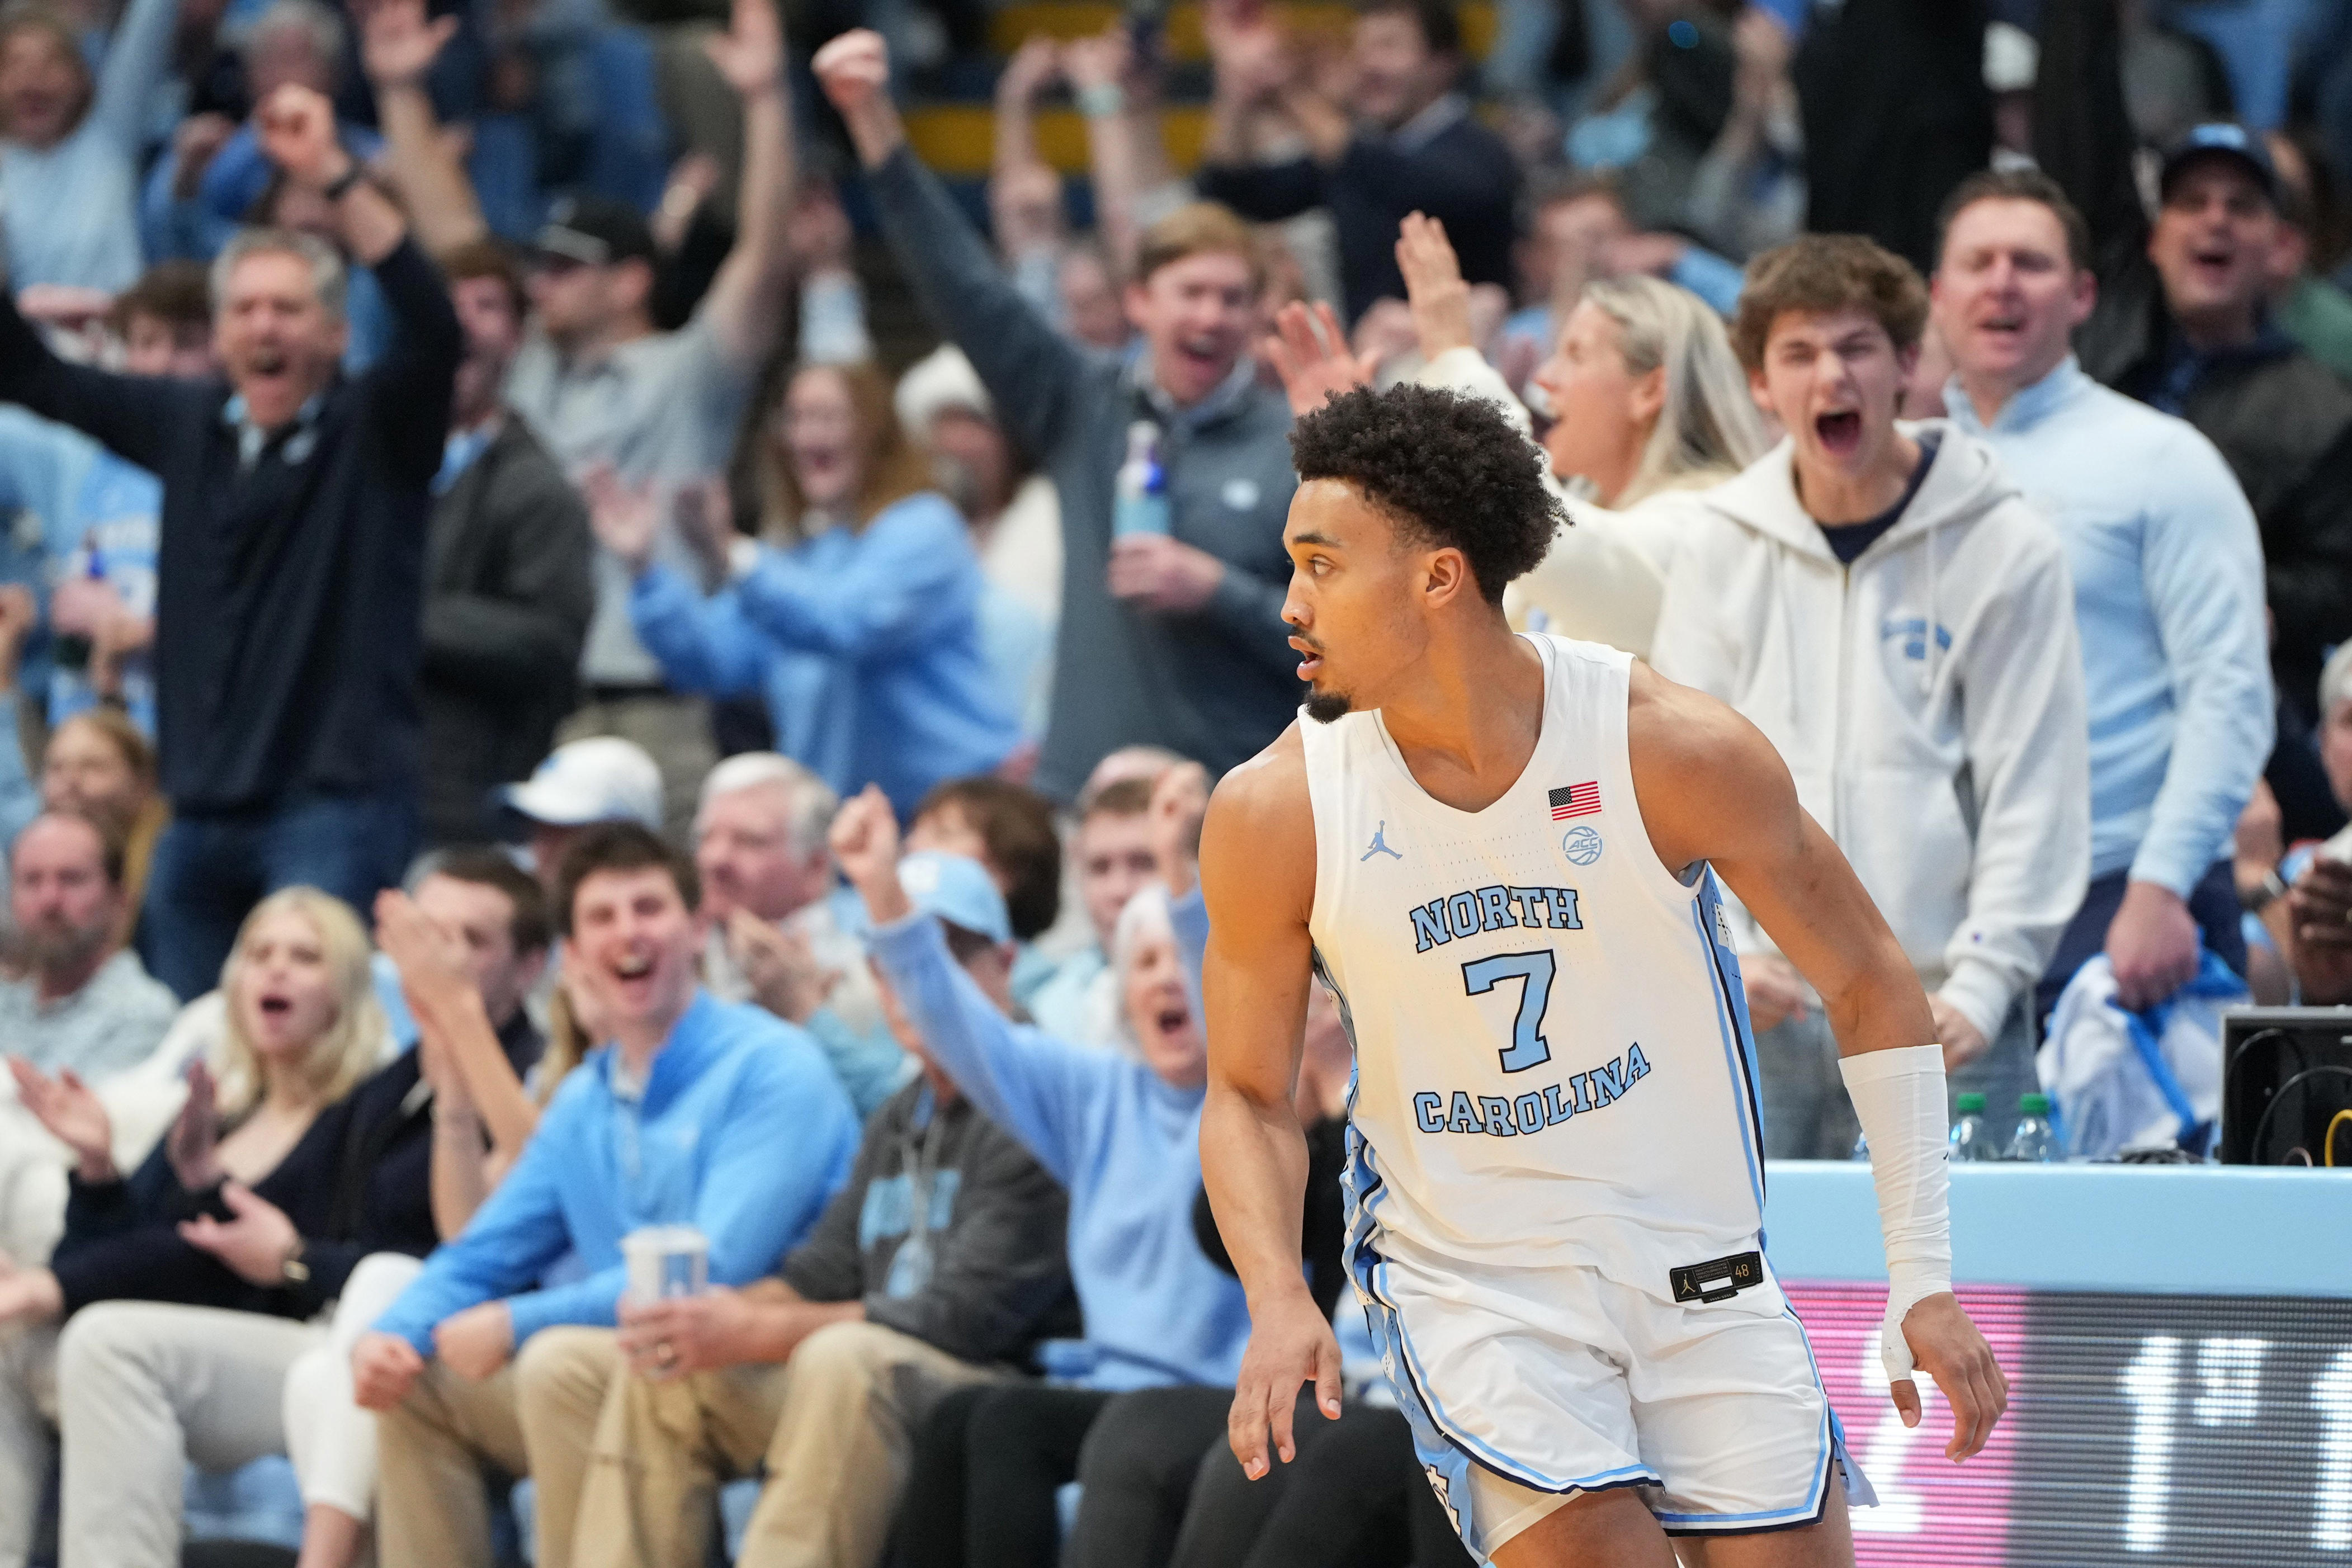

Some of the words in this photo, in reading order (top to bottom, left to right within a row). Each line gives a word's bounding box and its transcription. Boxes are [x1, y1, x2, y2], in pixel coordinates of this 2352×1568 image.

[1569, 837, 1599, 850] ACC
[1409, 885, 1583, 953] NORTH
[1461, 949, 1556, 1074] 7
[1413, 1042, 1651, 1137] CAROLINA
[1735, 1263, 1750, 1278] 48
